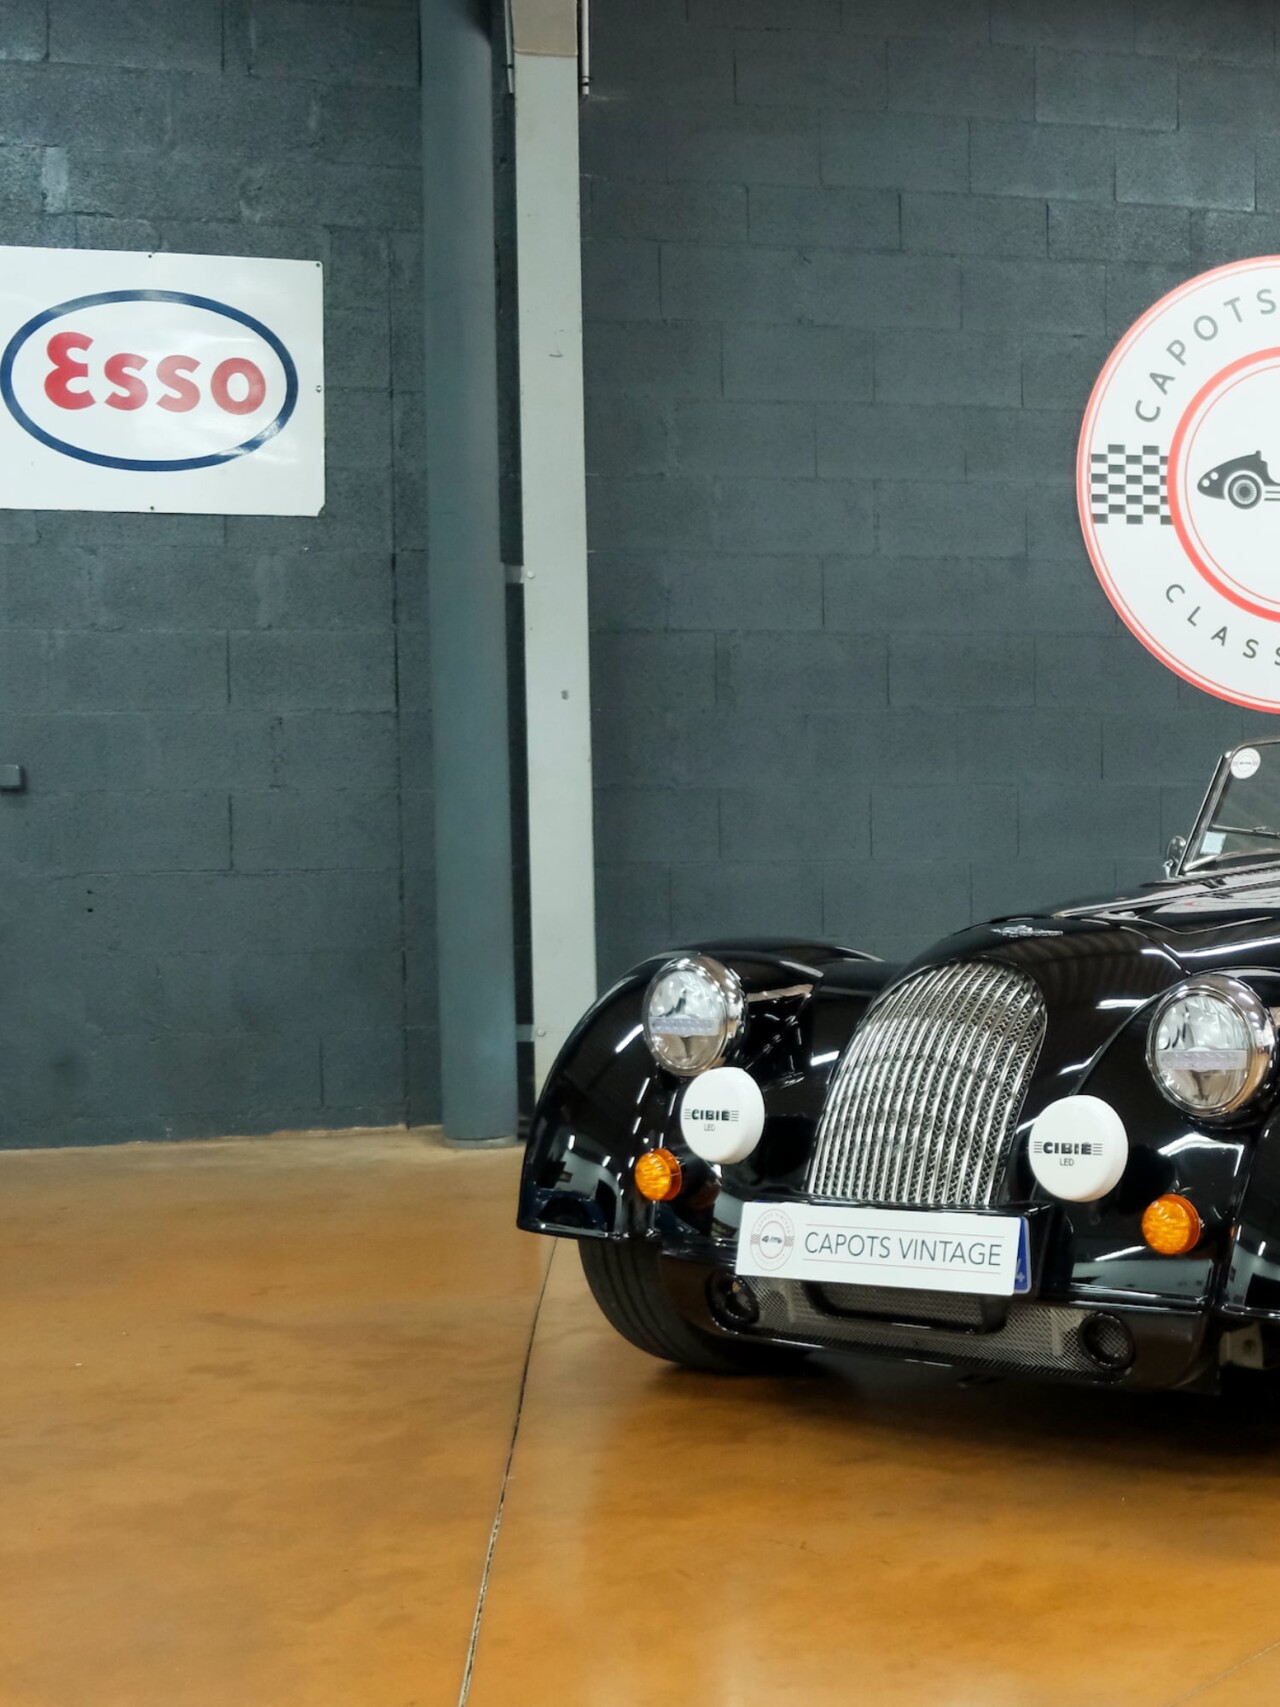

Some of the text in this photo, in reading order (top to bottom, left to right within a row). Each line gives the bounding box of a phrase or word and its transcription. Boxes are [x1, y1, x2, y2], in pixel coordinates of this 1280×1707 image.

[1135, 289, 1277, 422] CAPOTS
[704, 1124, 716, 1132] LED
[1059, 1158, 1075, 1166] LED
[804, 1231, 891, 1259] CAPOTS
[899, 1237, 1002, 1266] VINTAGE
